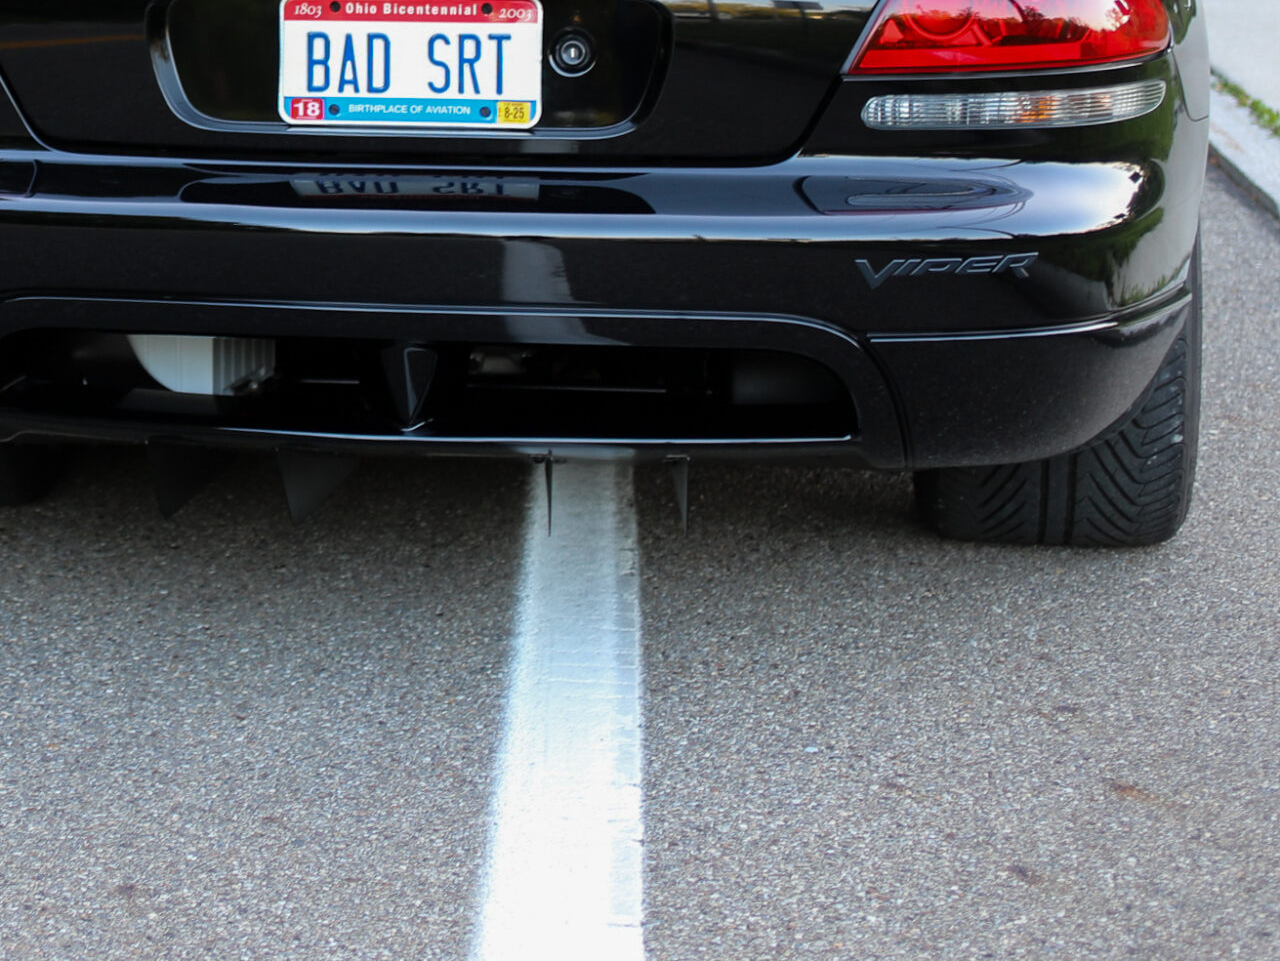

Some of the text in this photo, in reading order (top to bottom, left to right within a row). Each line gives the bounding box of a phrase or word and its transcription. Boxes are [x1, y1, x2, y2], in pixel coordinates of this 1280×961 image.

[294, 2, 322, 18] 1803
[345, 2, 477, 16] Ohio Bicentennial
[499, 9, 532, 21] 2003
[307, 32, 511, 94] BAD SRT
[293, 101, 320, 117] 18
[348, 104, 471, 115] BIRTHPLACE OF AVIATION
[855, 251, 1039, 289] VIPER
